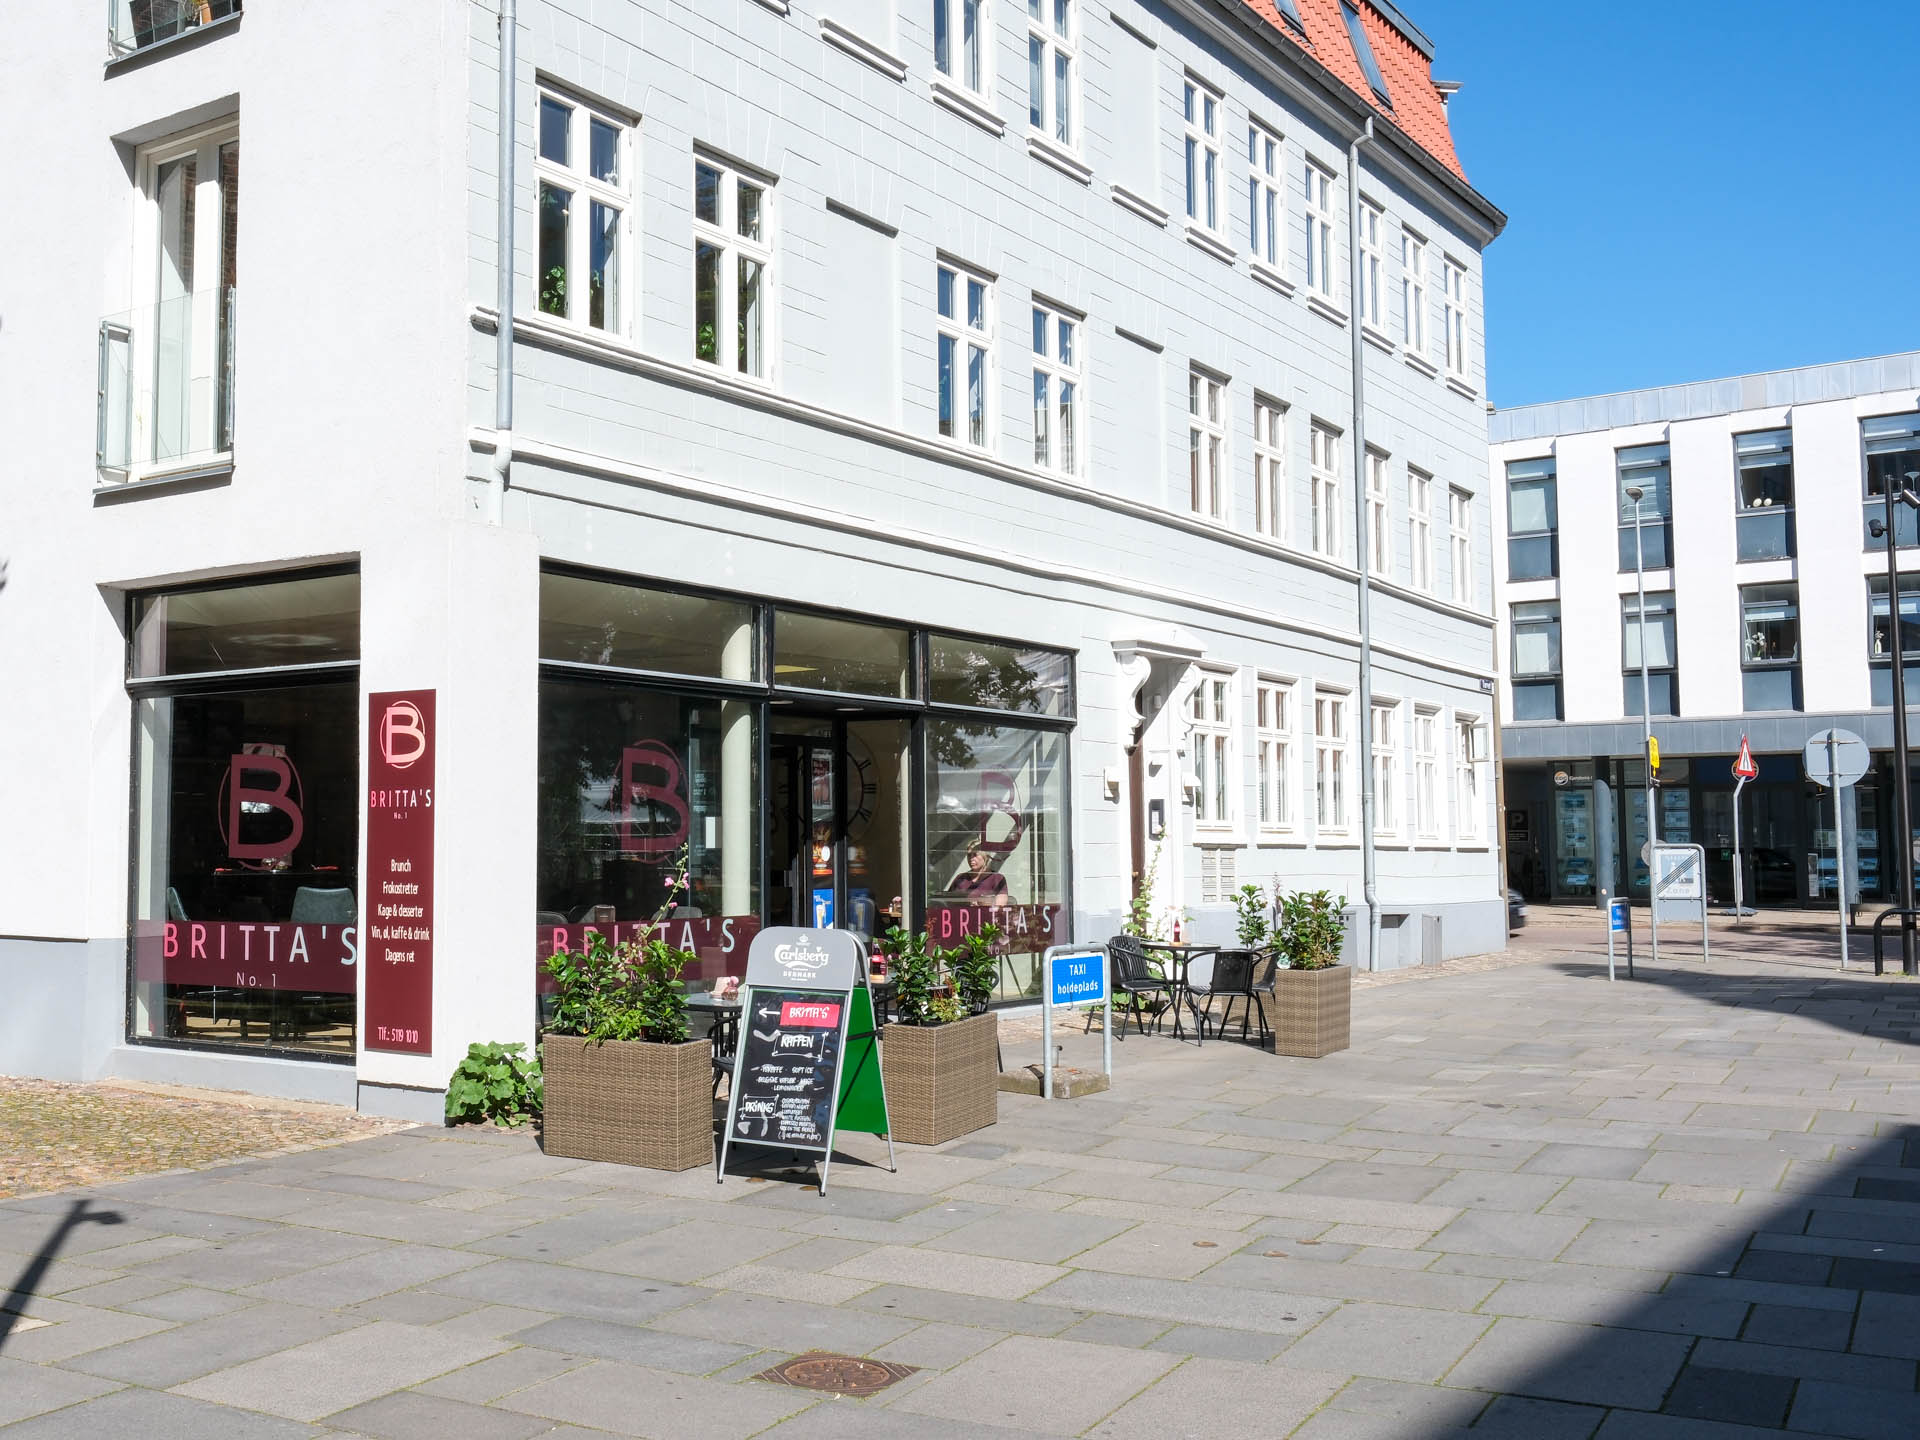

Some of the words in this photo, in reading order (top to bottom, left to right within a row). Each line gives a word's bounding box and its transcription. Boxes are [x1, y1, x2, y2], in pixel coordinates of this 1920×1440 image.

[385, 706, 426, 764] B
[229, 753, 303, 859] B
[370, 789, 432, 808] BRITTA'S
[622, 747, 690, 852] B
[393, 811, 404, 820] No.
[390, 858, 412, 872] Brunch
[382, 880, 419, 895] Frokostretter
[377, 903, 393, 919] Kage
[393, 903, 398, 917] &
[398, 903, 424, 918] desserter
[371, 925, 383, 940] Vin,
[391, 925, 408, 940] kaffe
[408, 926, 413, 940] &
[413, 926, 430, 941] drink
[163, 922, 357, 966] BRITTA'S
[385, 947, 406, 965] Dagens
[406, 950, 415, 963] ret
[774, 943, 830, 968] Carlsberg
[1069, 963, 1087, 977] TAXI
[235, 971, 263, 988] No.
[271, 973, 277, 988] 1
[1057, 979, 1099, 995] holdeplads
[377, 1026, 390, 1041] Tlf.:
[405, 1029, 419, 1044] 1010
[780, 1034, 815, 1049] KAFFEN
